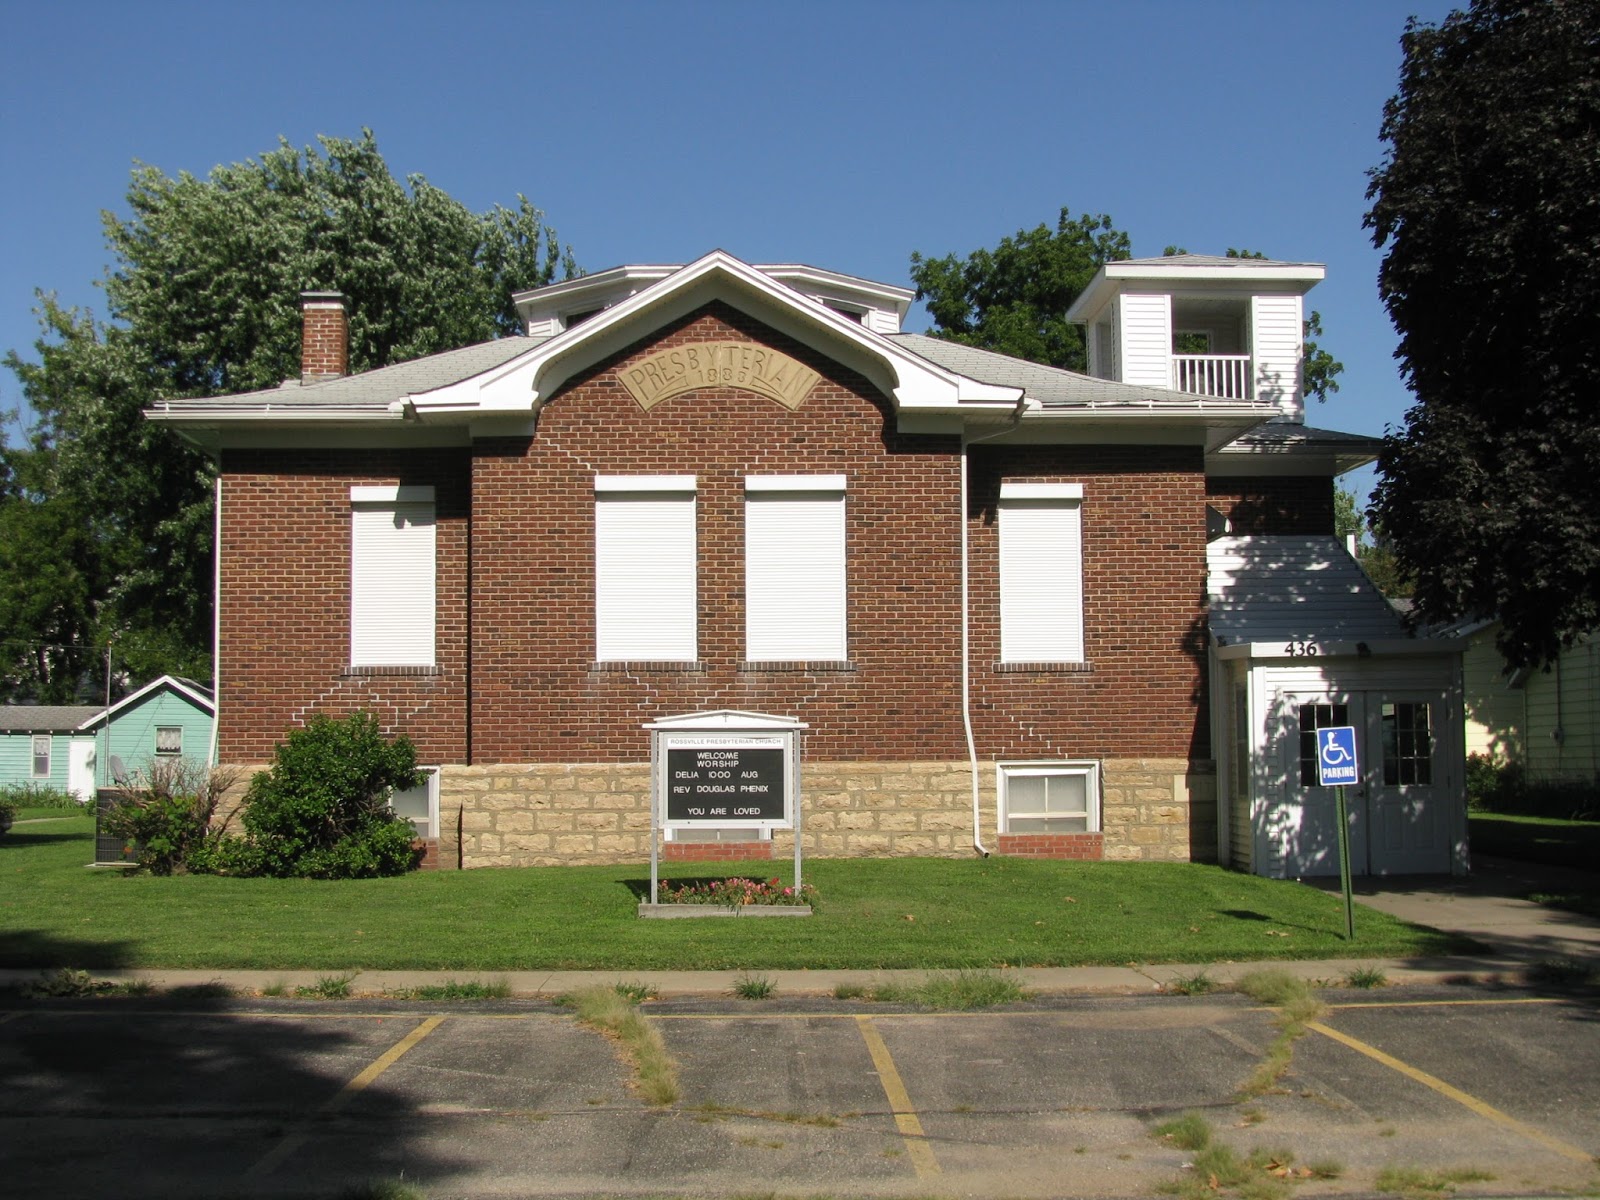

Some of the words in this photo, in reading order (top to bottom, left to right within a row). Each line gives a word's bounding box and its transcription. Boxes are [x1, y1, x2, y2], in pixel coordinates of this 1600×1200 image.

[629, 345, 814, 400] PRESBYTERIAN
[1284, 641, 1317, 657] 436
[697, 752, 739, 760] WELCOME
[697, 760, 739, 768] WORSHIP
[1322, 766, 1355, 779] PARKING
[673, 786, 691, 794] REV
[696, 785, 736, 793] DOUGLAS
[740, 785, 769, 793] PHENIX
